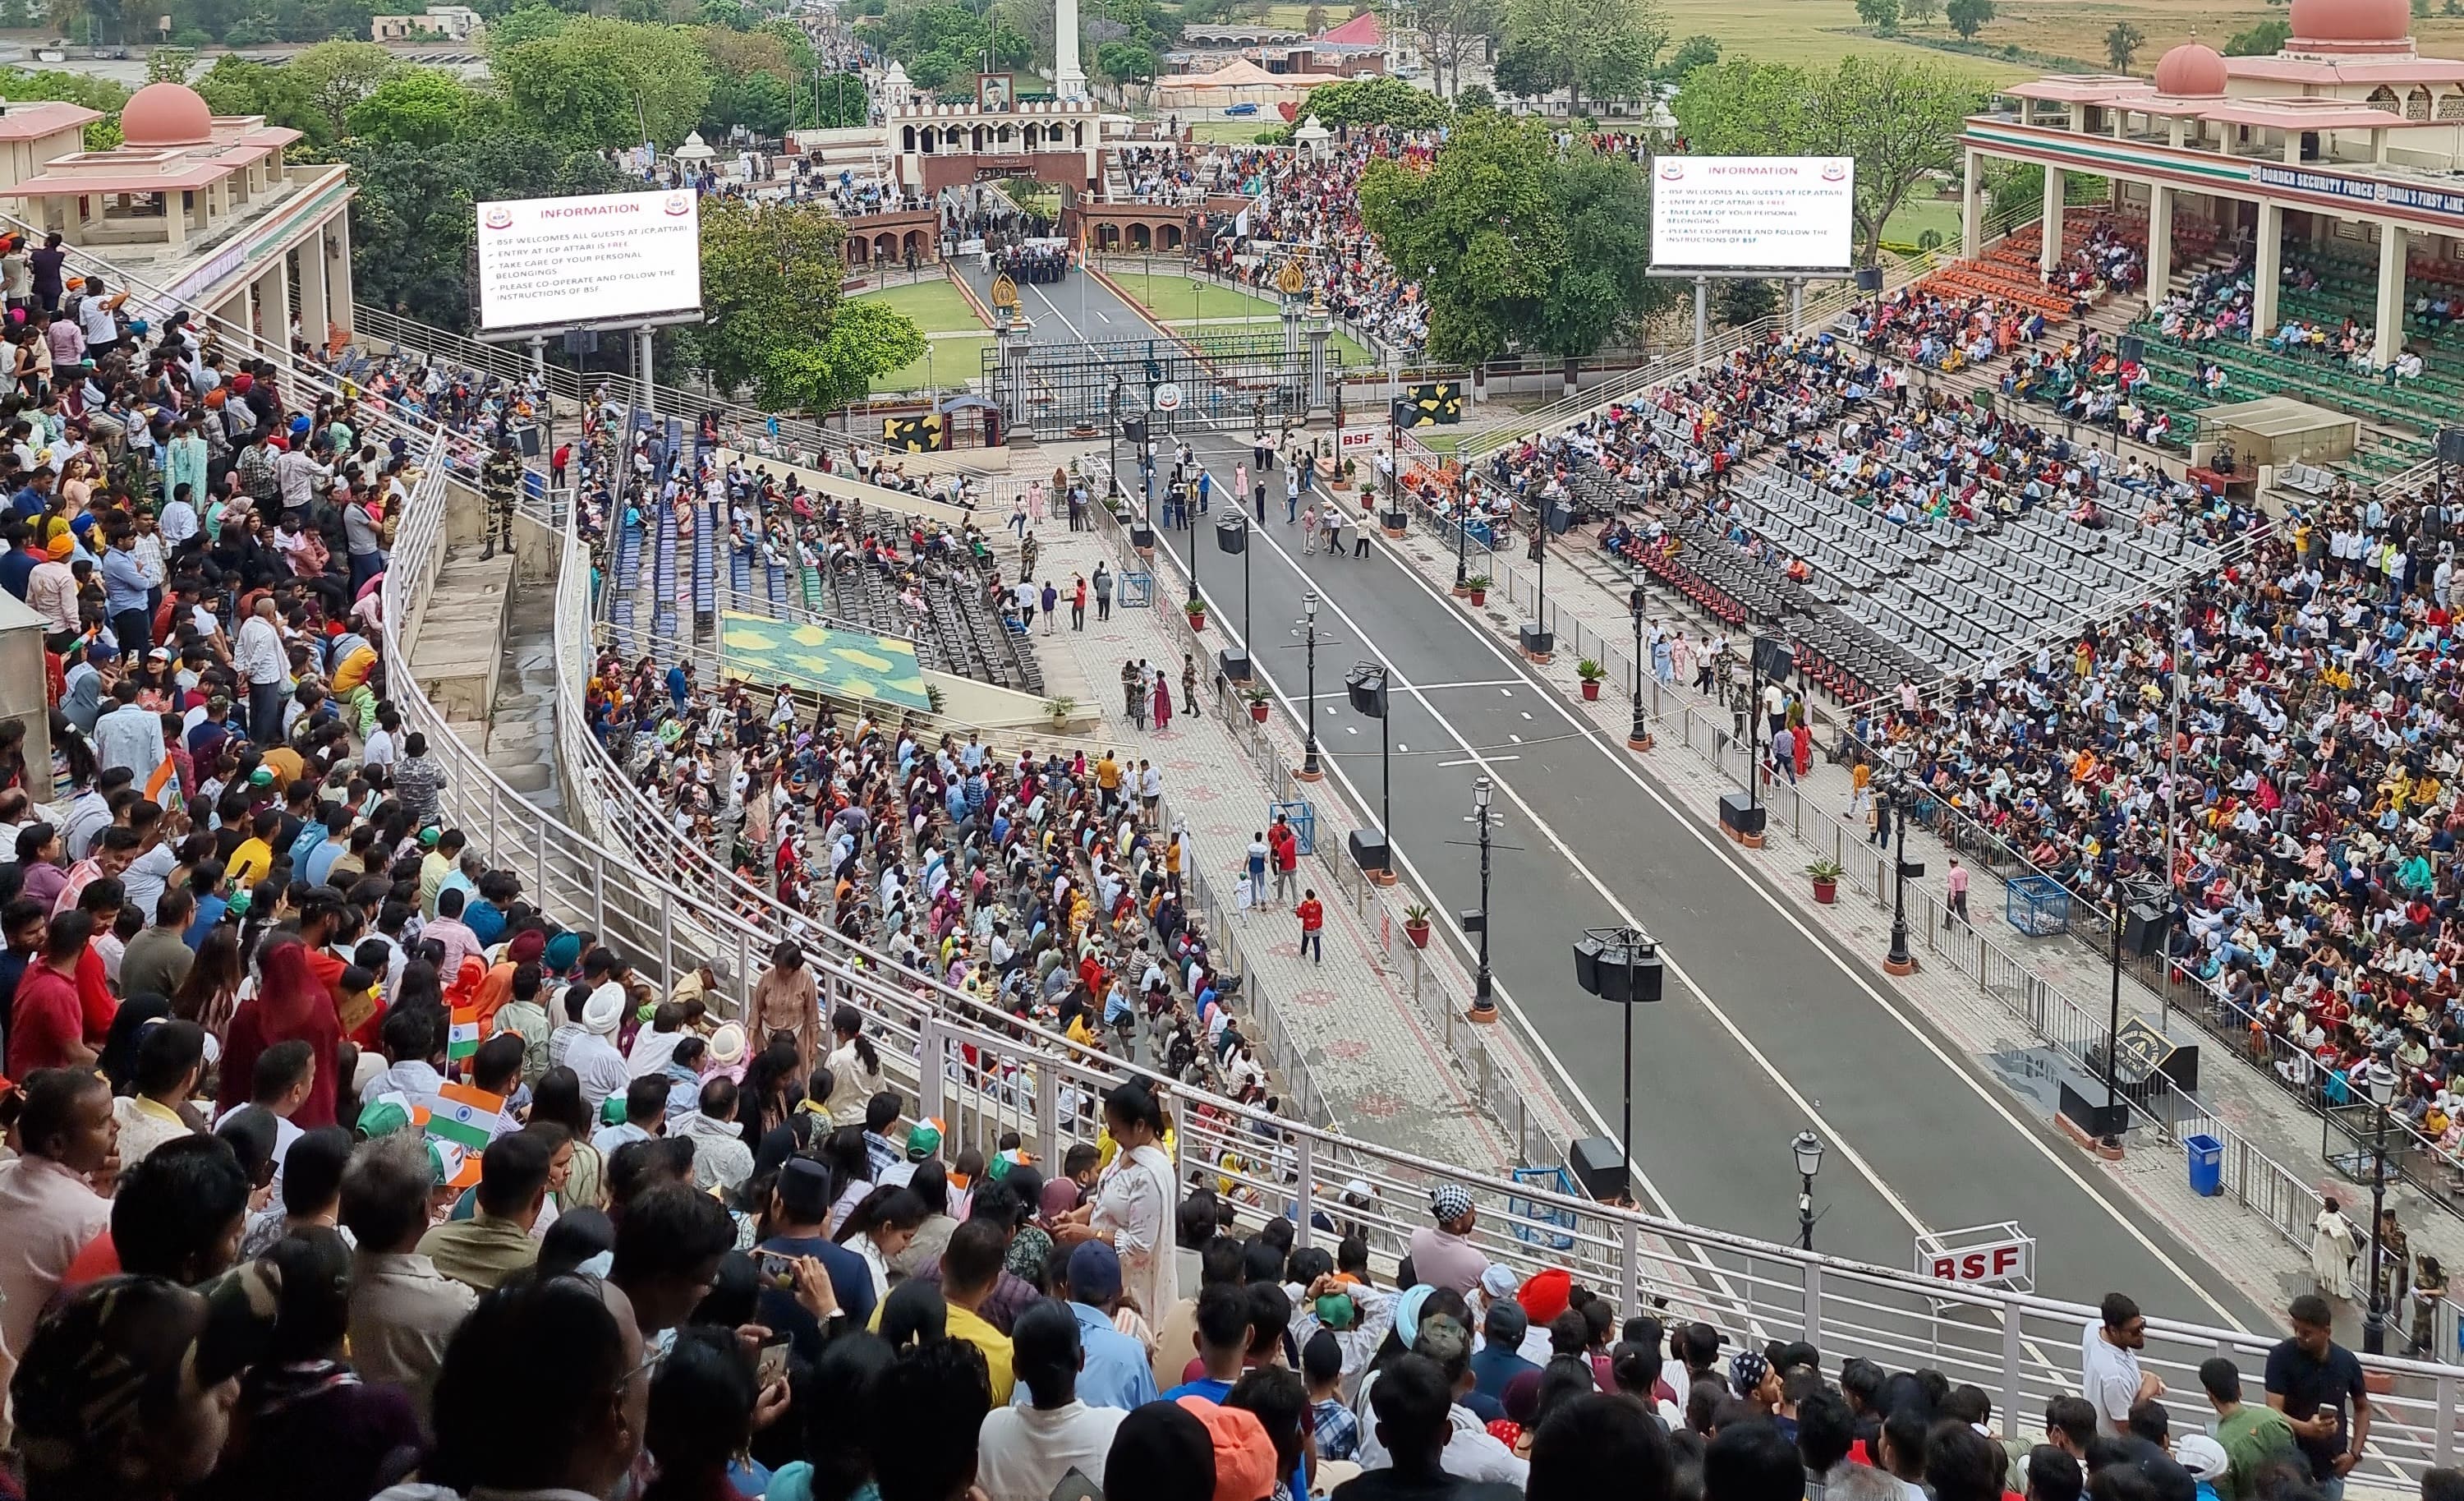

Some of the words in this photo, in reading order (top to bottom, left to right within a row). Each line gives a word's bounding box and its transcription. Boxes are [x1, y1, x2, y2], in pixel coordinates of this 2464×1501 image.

[1009, 167, 1037, 178] باب
[2261, 168, 2296, 186] BORDER
[2296, 173, 2341, 192] SECURITY
[2342, 180, 2374, 198] FORCE
[2388, 186, 2417, 205] INDIA'S
[2418, 191, 2443, 209] FIRST
[2444, 195, 2464, 212] LINE
[540, 204, 640, 219] INFORMATION
[517, 234, 570, 244] WELCOMES
[591, 230, 625, 238] GUESTS
[499, 249, 528, 257] ENTRY
[595, 251, 642, 261] PERSONAL
[496, 269, 557, 279] BELONGINGS
[499, 282, 533, 291] PLEASE
[536, 277, 594, 288] CO-OPERATE
[619, 271, 656, 280] FOLLOW
[497, 288, 567, 301] INSTRUCTIONS
[1343, 433, 1374, 445] BSF
[1402, 435, 1418, 455] BSF
[1933, 1246, 2019, 1281] BSF
